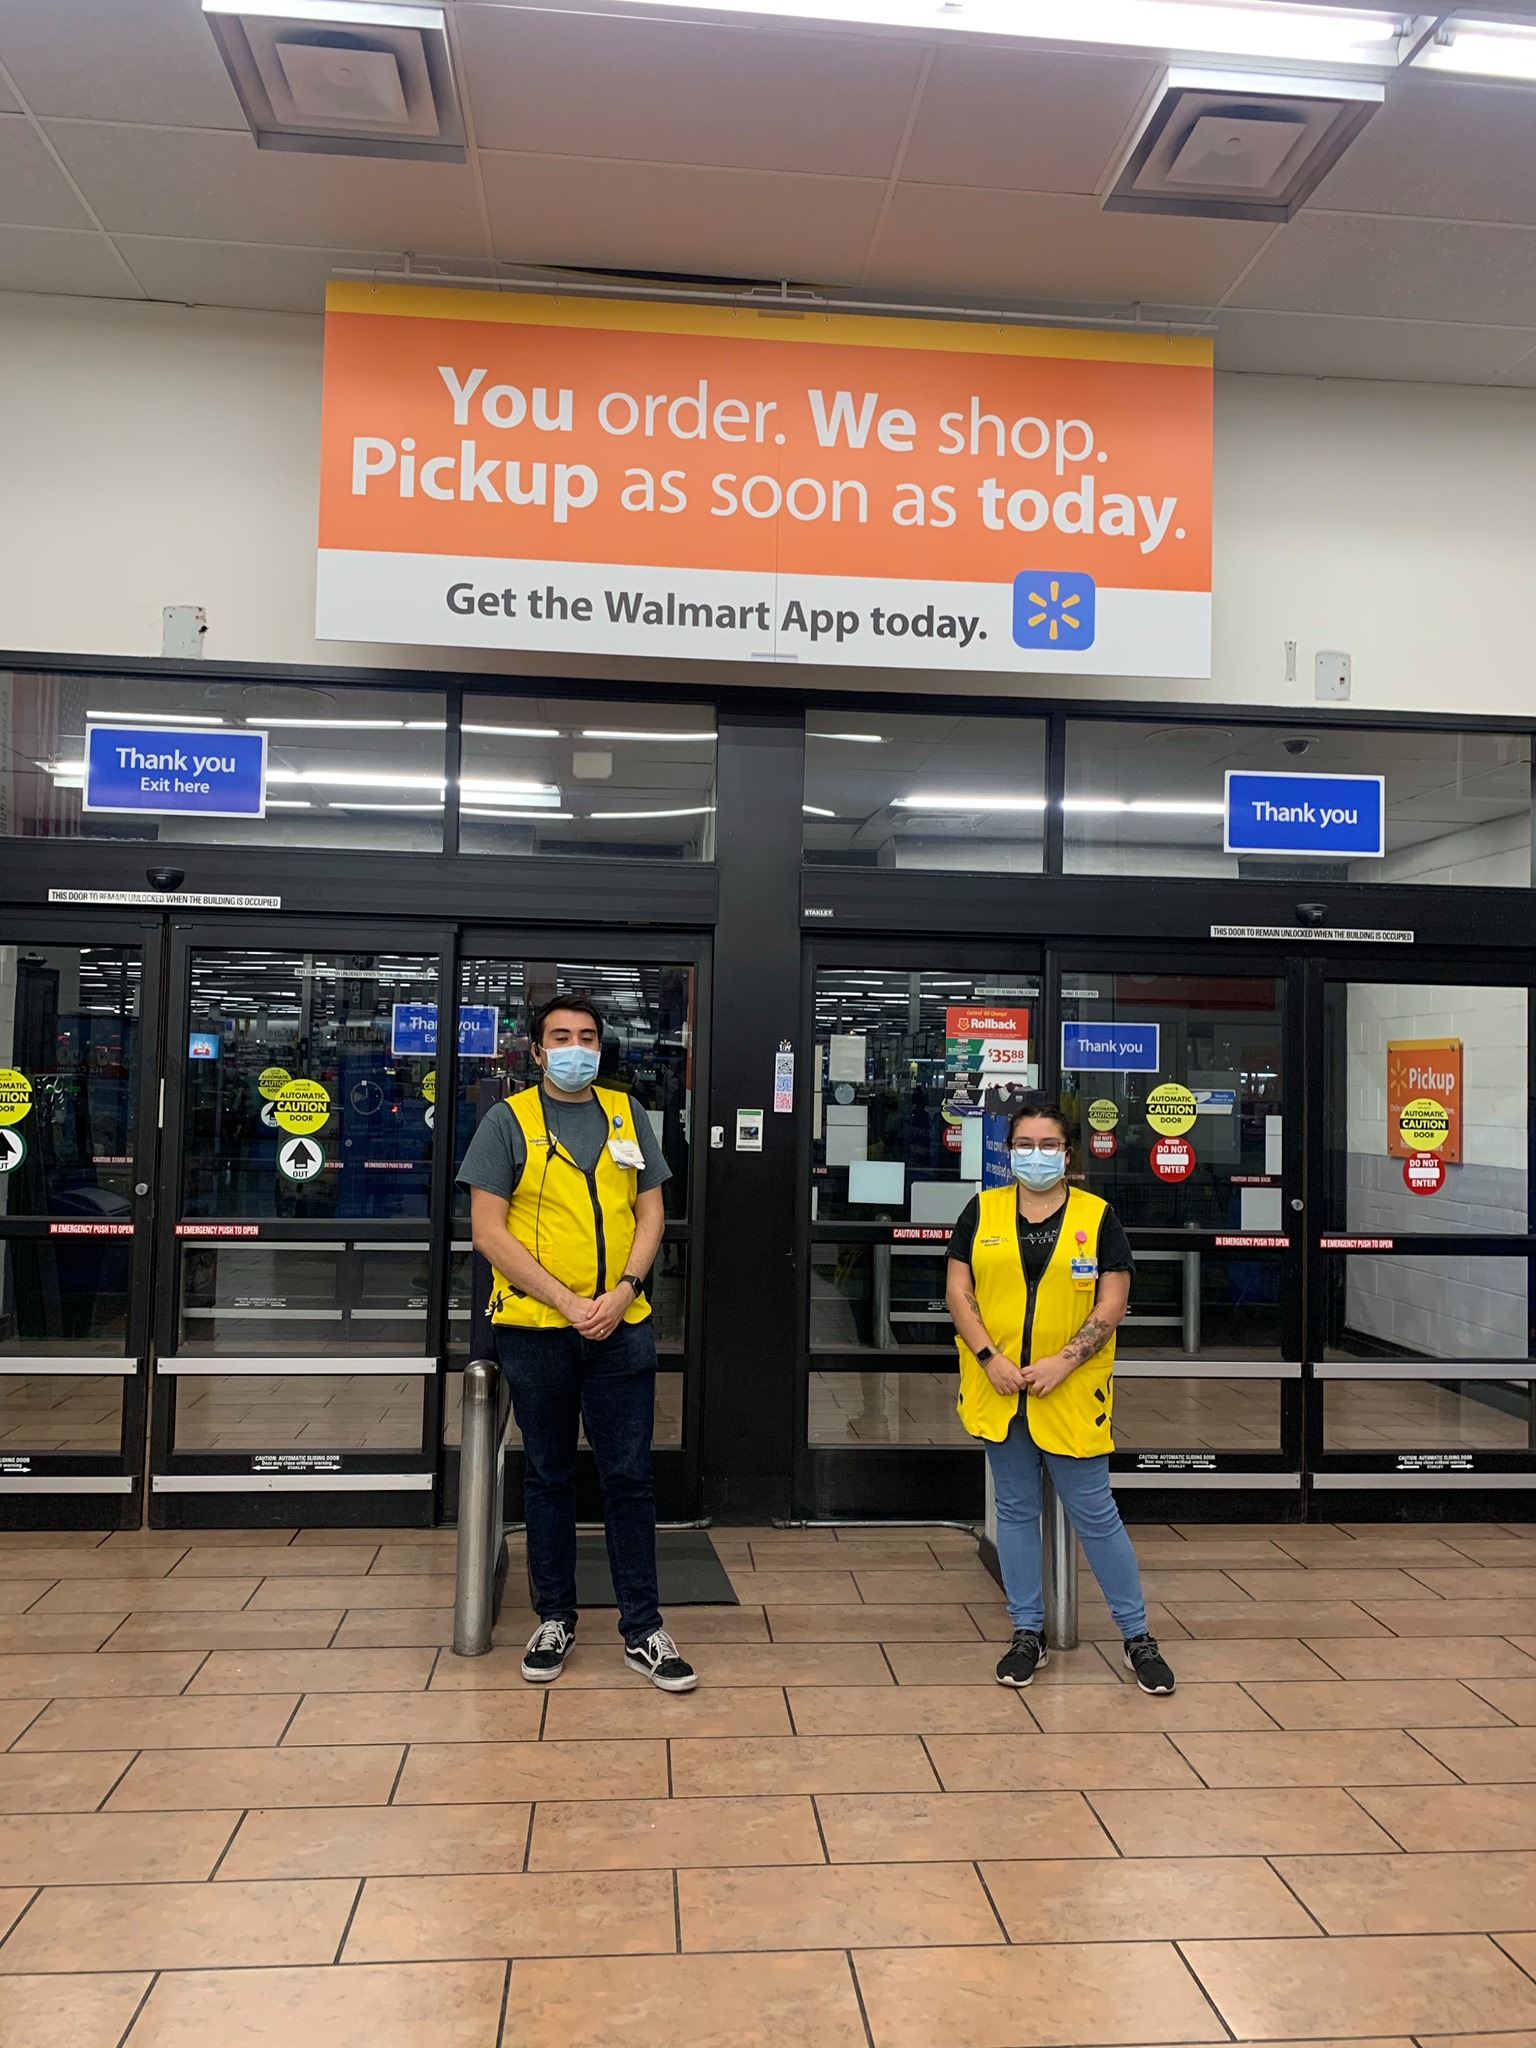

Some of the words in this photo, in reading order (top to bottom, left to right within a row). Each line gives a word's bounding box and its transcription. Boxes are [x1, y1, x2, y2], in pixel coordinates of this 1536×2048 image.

[438, 366, 575, 433] You
[597, 381, 786, 445] order.
[808, 389, 915, 451] We
[937, 397, 1108, 471] shop.
[351, 436, 597, 522] Pickup
[621, 467, 687, 513] as
[711, 474, 868, 523] soon
[892, 480, 956, 529] as
[976, 476, 1186, 554] today.
[445, 583, 515, 620] Get
[526, 588, 593, 624] the
[604, 592, 770, 632] Walmart
[781, 601, 857, 646] App
[870, 606, 988, 650] today.
[116, 747, 188, 771] Thank
[192, 756, 236, 777] you
[140, 777, 170, 792] Exit
[174, 778, 210, 794] here
[1252, 801, 1316, 823] Thank
[1320, 808, 1358, 829] you
[52, 891, 67, 900] THIS
[68, 891, 88, 901] DOOR
[89, 892, 98, 901] TO
[99, 892, 127, 902] REMAIN
[128, 893, 164, 903] UNLOCKED
[166, 894, 187, 903] WHEN
[189, 895, 202, 904] THE
[203, 895, 236, 905] BUILDING
[236, 897, 243, 905] IS
[244, 897, 278, 906] OCCUPIED
[804, 908, 834, 917] STANLEY
[1213, 927, 1228, 936] THIS
[1228, 927, 1246, 936] DOOR
[1246, 928, 1255, 937] TO
[1255, 928, 1280, 937] REMAIN
[1280, 929, 1313, 938] UNLOCKED
[1313, 930, 1333, 938] WHEN
[1334, 930, 1345, 938] THE
[1346, 931, 1375, 940] BUILDING
[1382, 932, 1412, 940] OCCUPIED
[410, 1016, 437, 1030] Tha
[971, 1018, 1016, 1030] Rollback
[1078, 1039, 1117, 1053] Thank
[1119, 1043, 1143, 1056] you
[0, 1082, 27, 1090] MATIC
[1409, 1067, 1455, 1096] Pickup
[0, 1092, 29, 1103] TION
[280, 1092, 325, 1100] AUTOMATIC
[1150, 1095, 1192, 1103] AUTOMATIC
[277, 1101, 327, 1112] CAUTION
[1148, 1105, 1193, 1114] CAUTION
[290, 1114, 313, 1122] DOOR
[1404, 1110, 1444, 1118] AUTOMATIC
[1402, 1119, 1446, 1129] CAUTION
[1413, 1131, 1435, 1139] DOOR
[1157, 1145, 1169, 1153] DO
[1170, 1145, 1187, 1154] NOT
[1409, 1159, 1421, 1167] DO
[1422, 1159, 1438, 1168] NOT
[293, 1170, 309, 1178] OUT
[1160, 1165, 1186, 1174] ENTER
[1411, 1179, 1437, 1187] ENTER
[50, 1223, 57, 1233] IN
[58, 1223, 93, 1234] EMERGENCY
[93, 1224, 109, 1234] PUSH
[109, 1224, 117, 1234] TO
[118, 1224, 134, 1235] OPEN
[175, 1225, 182, 1234] IN
[183, 1225, 218, 1235] EMERGENCY
[218, 1225, 233, 1235] PUSH
[234, 1225, 242, 1235] TO
[242, 1225, 259, 1235] OPEN
[893, 1228, 920, 1238] CAUTION
[922, 1229, 943, 1239] STAND
[945, 1229, 953, 1239] BA
[1215, 1236, 1222, 1246] IN
[1222, 1236, 1253, 1246] EMERGENCY
[1253, 1237, 1267, 1247] PUSH
[1268, 1237, 1275, 1247] TO
[1275, 1238, 1290, 1247] OPEN
[1320, 1238, 1326, 1248] IN
[1327, 1239, 1357, 1248] EMERGENCY
[1357, 1239, 1371, 1248] PUSH
[1371, 1239, 1379, 1248] TO
[1379, 1239, 1393, 1249] OPEN
